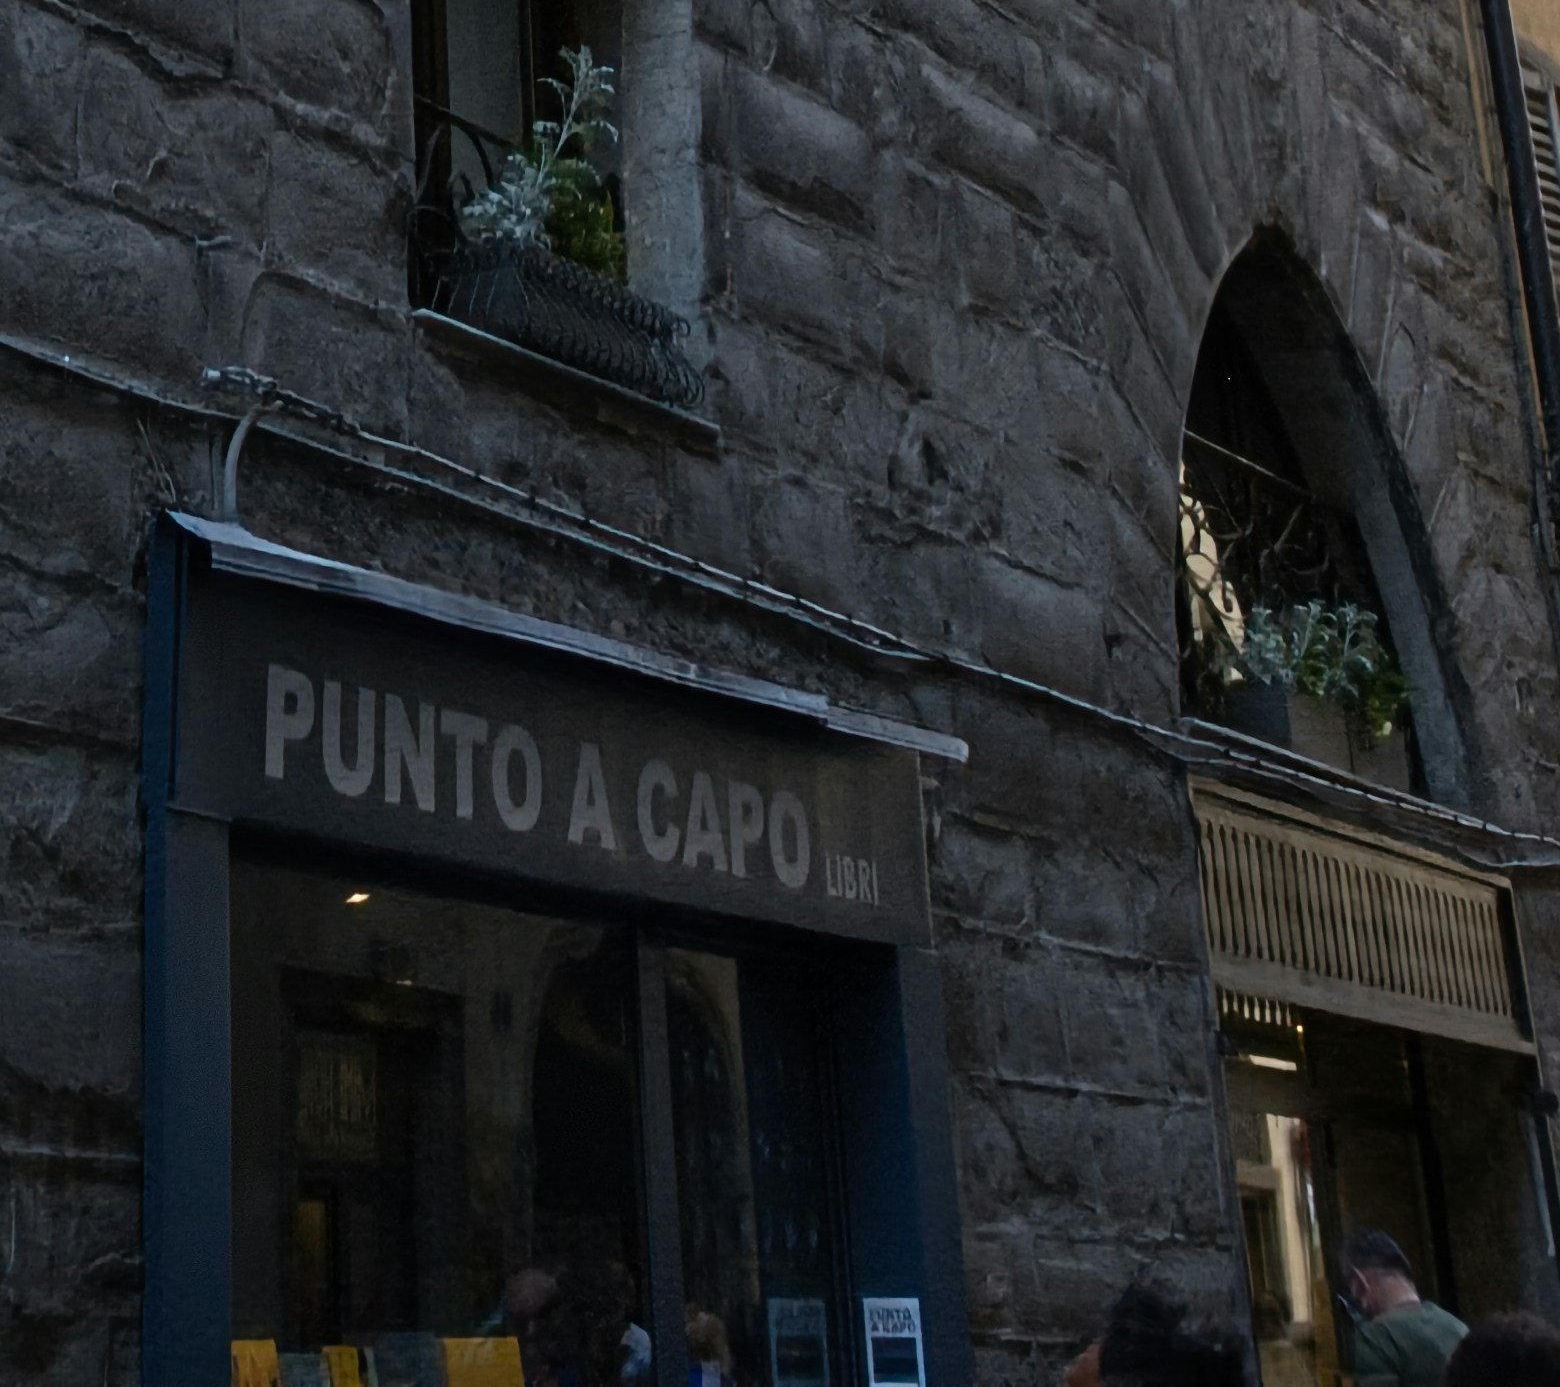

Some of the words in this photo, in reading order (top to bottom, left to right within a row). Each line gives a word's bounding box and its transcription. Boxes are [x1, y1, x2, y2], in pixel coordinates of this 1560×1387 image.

[265, 663, 542, 832] PUNTO
[568, 743, 617, 851] A
[637, 758, 811, 889] CAPO
[824, 851, 879, 906] LIBRI
